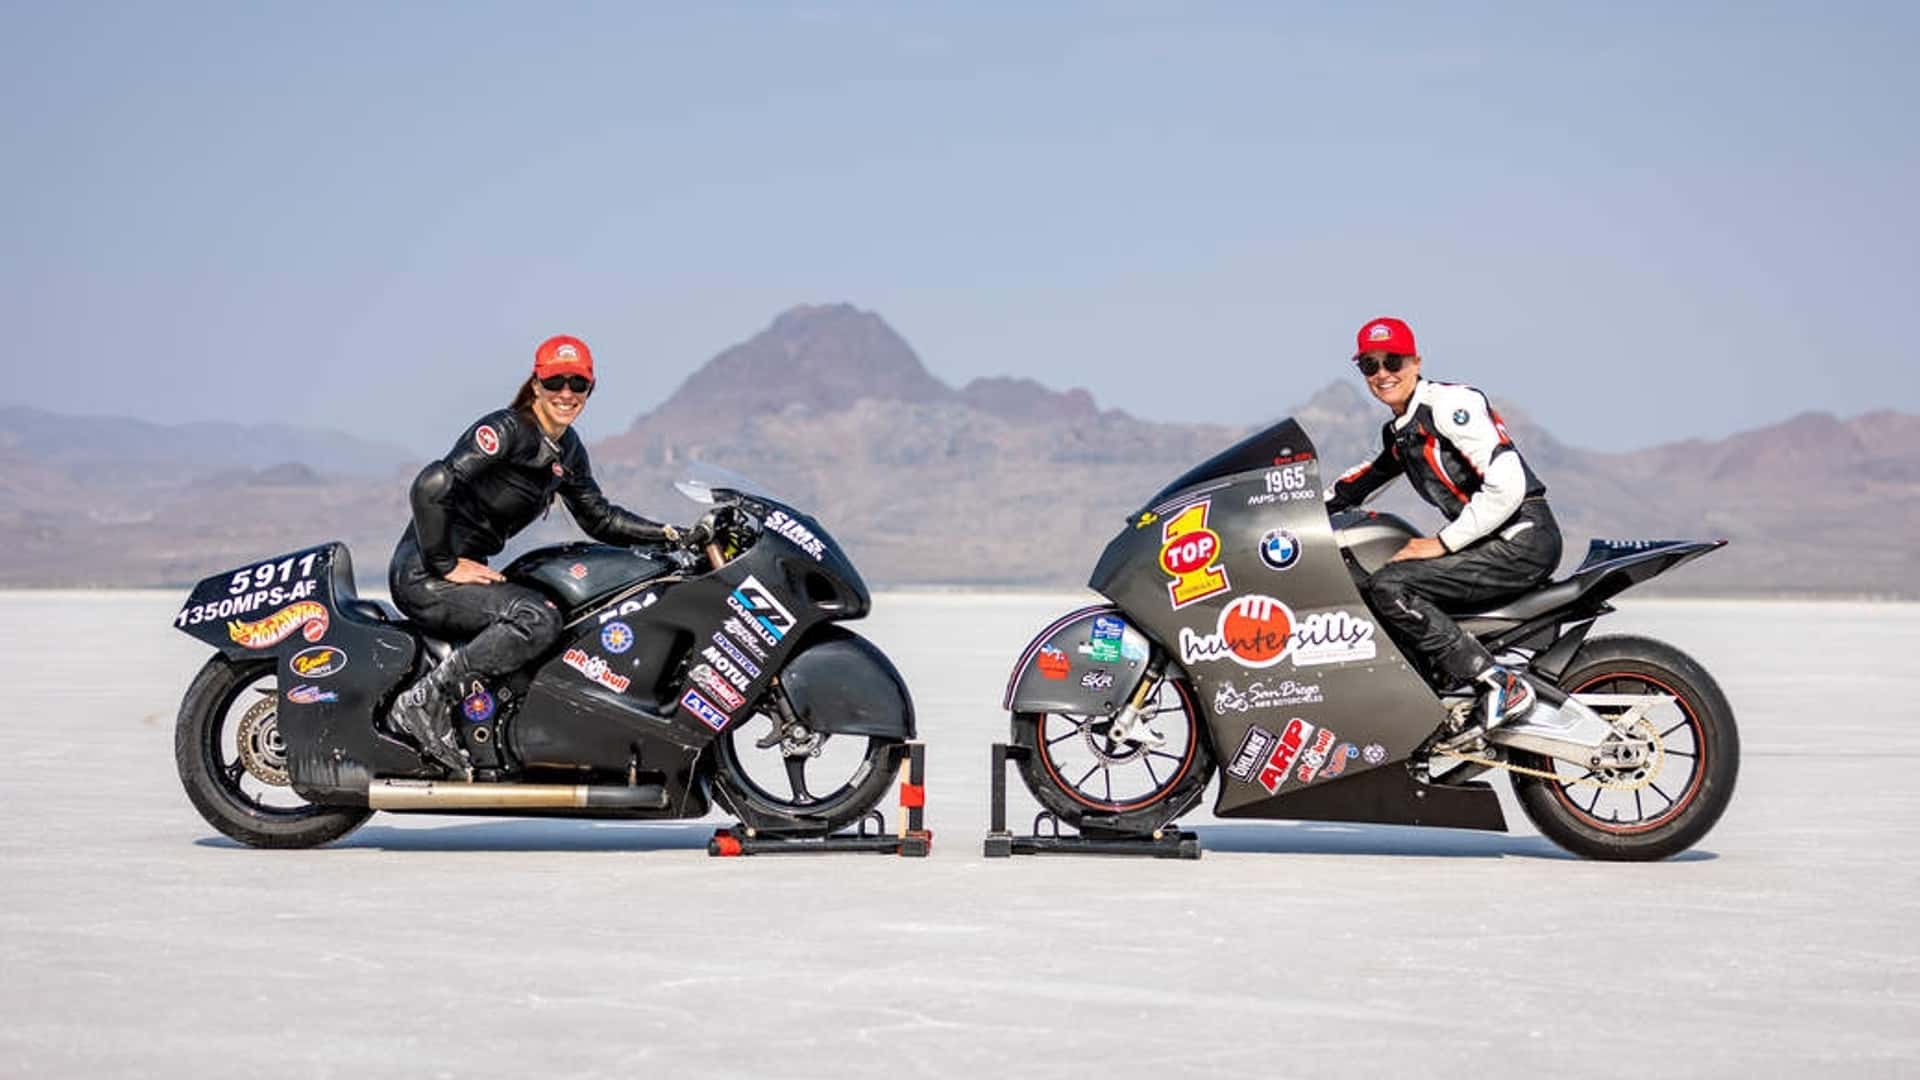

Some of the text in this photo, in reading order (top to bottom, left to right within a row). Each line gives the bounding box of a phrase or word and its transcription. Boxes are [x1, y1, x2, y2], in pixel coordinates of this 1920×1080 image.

[1264, 466, 1305, 493] 1965
[229, 553, 317, 595] 5911
[176, 579, 317, 627] 1350MPS-AF
[727, 596, 778, 647] CARRILLO
[564, 649, 629, 691] pit bull
[702, 646, 751, 692] MOTUL
[684, 694, 726, 727] APE
[1249, 681, 1319, 702] San Diego
[1259, 719, 1304, 791] ARP
